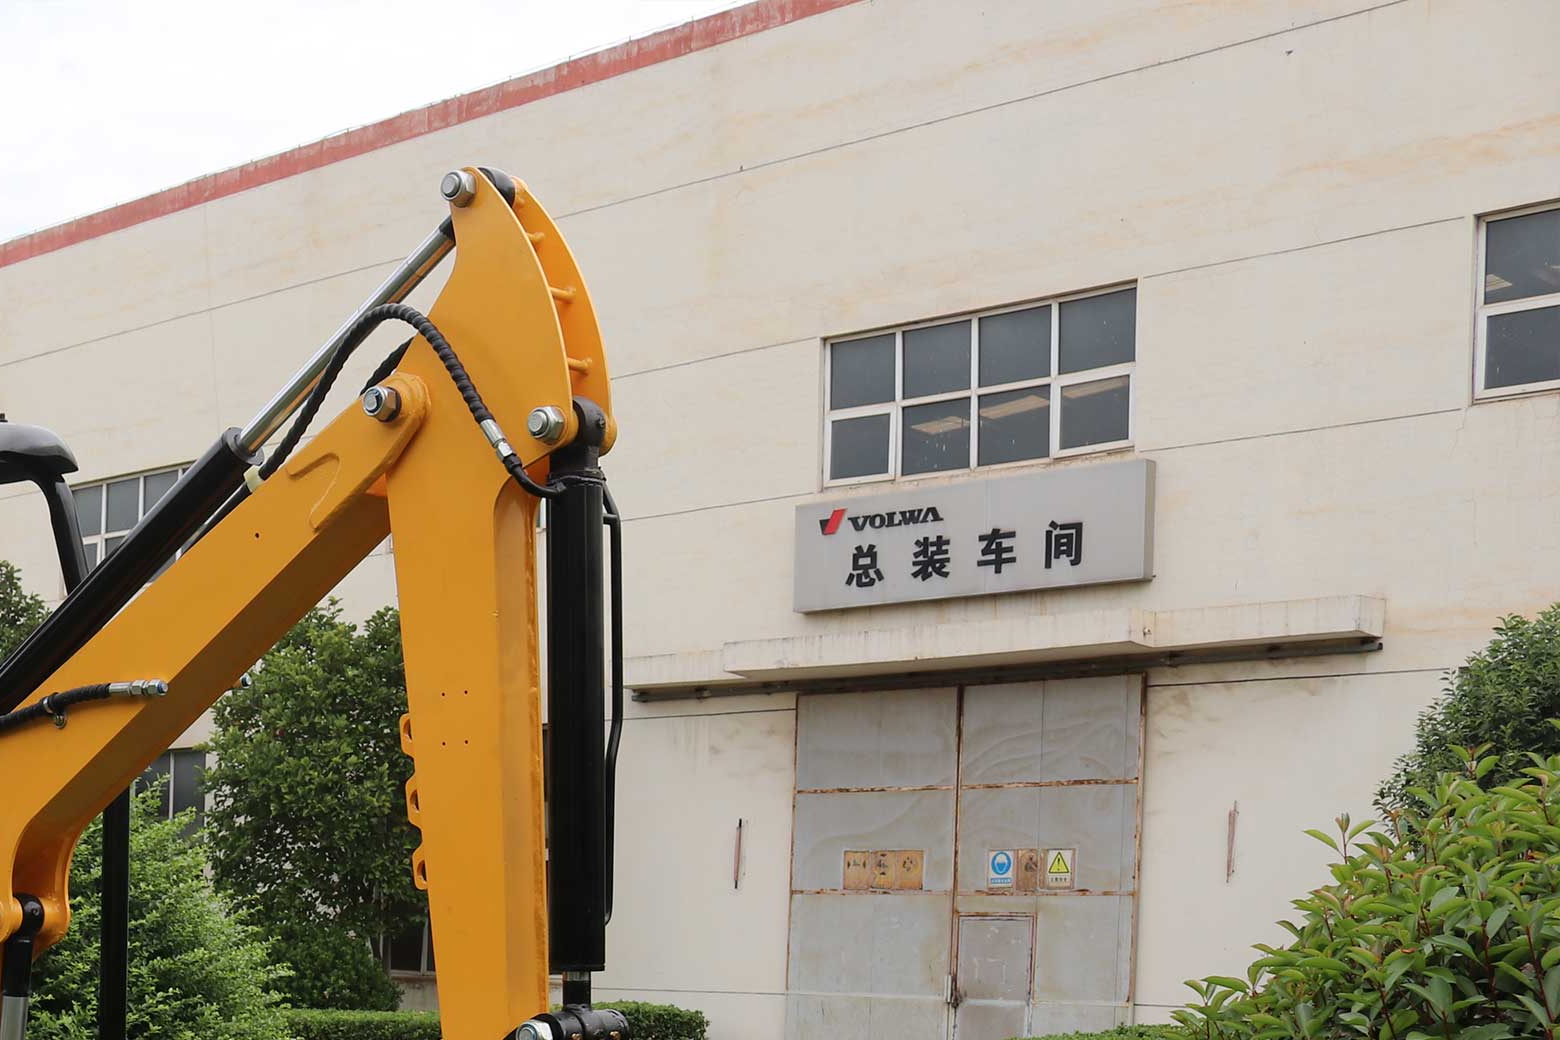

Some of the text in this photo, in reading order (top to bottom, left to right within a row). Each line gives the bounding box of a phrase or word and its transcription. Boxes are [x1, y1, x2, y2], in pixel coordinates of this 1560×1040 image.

[847, 506, 944, 532] VOLWA
[845, 520, 1083, 588] 总装车间
